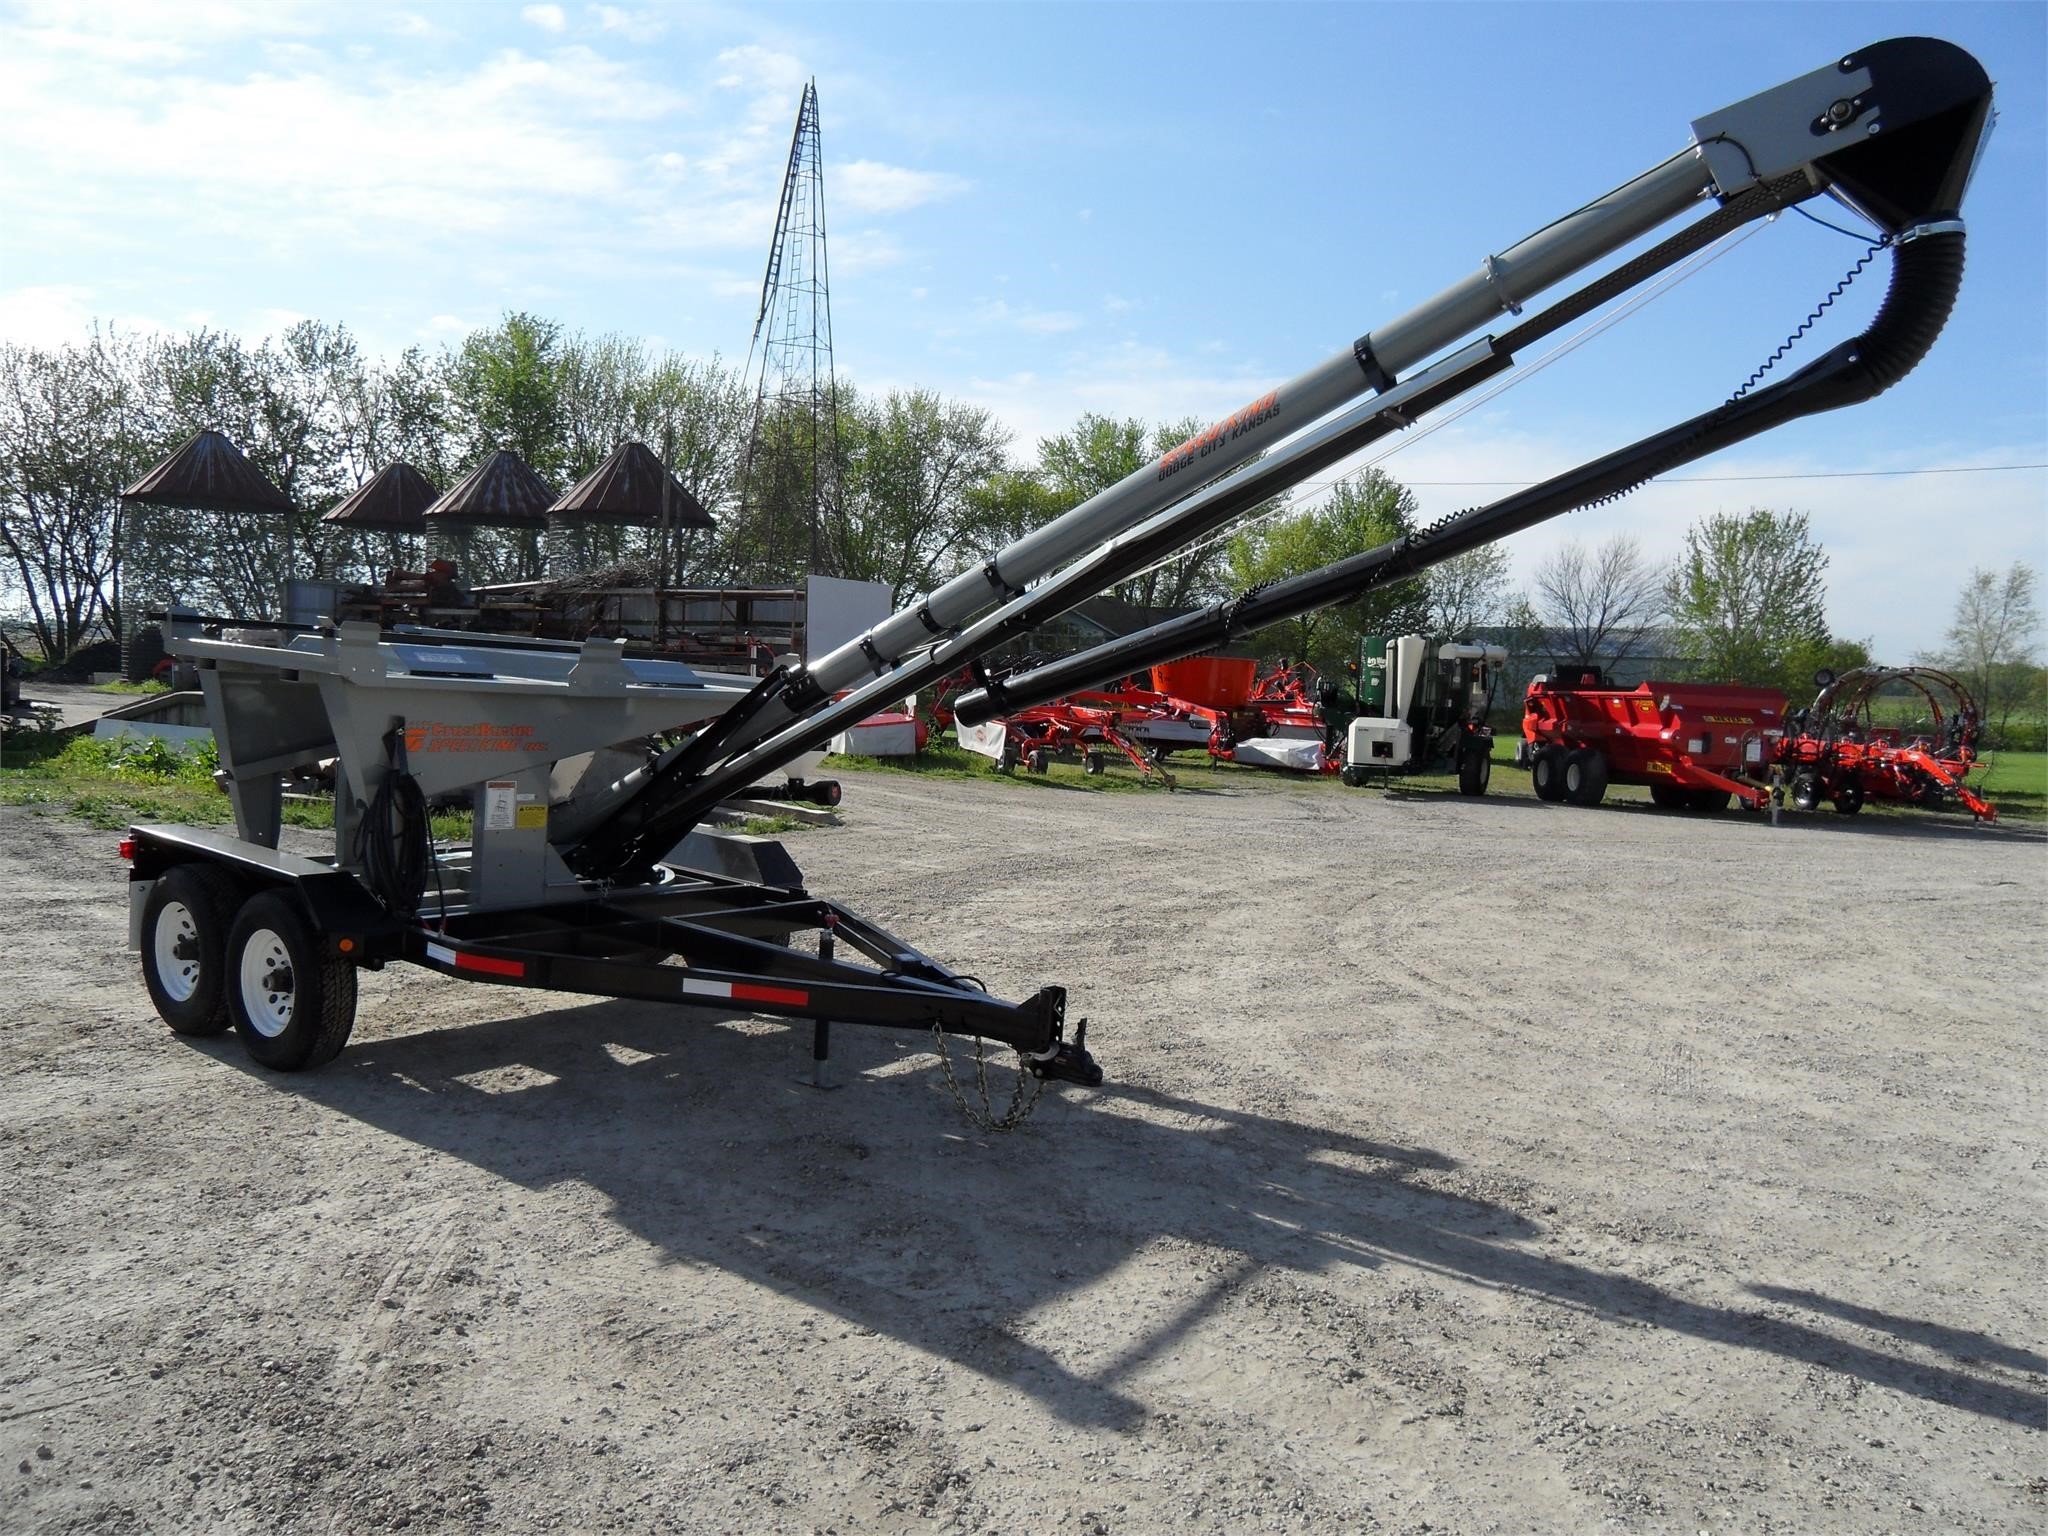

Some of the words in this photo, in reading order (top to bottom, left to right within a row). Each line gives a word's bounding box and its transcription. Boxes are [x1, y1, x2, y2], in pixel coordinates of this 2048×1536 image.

[1158, 455, 1194, 481] DODGE
[1200, 433, 1226, 458] CITY
[1232, 403, 1280, 440] KANSAS
